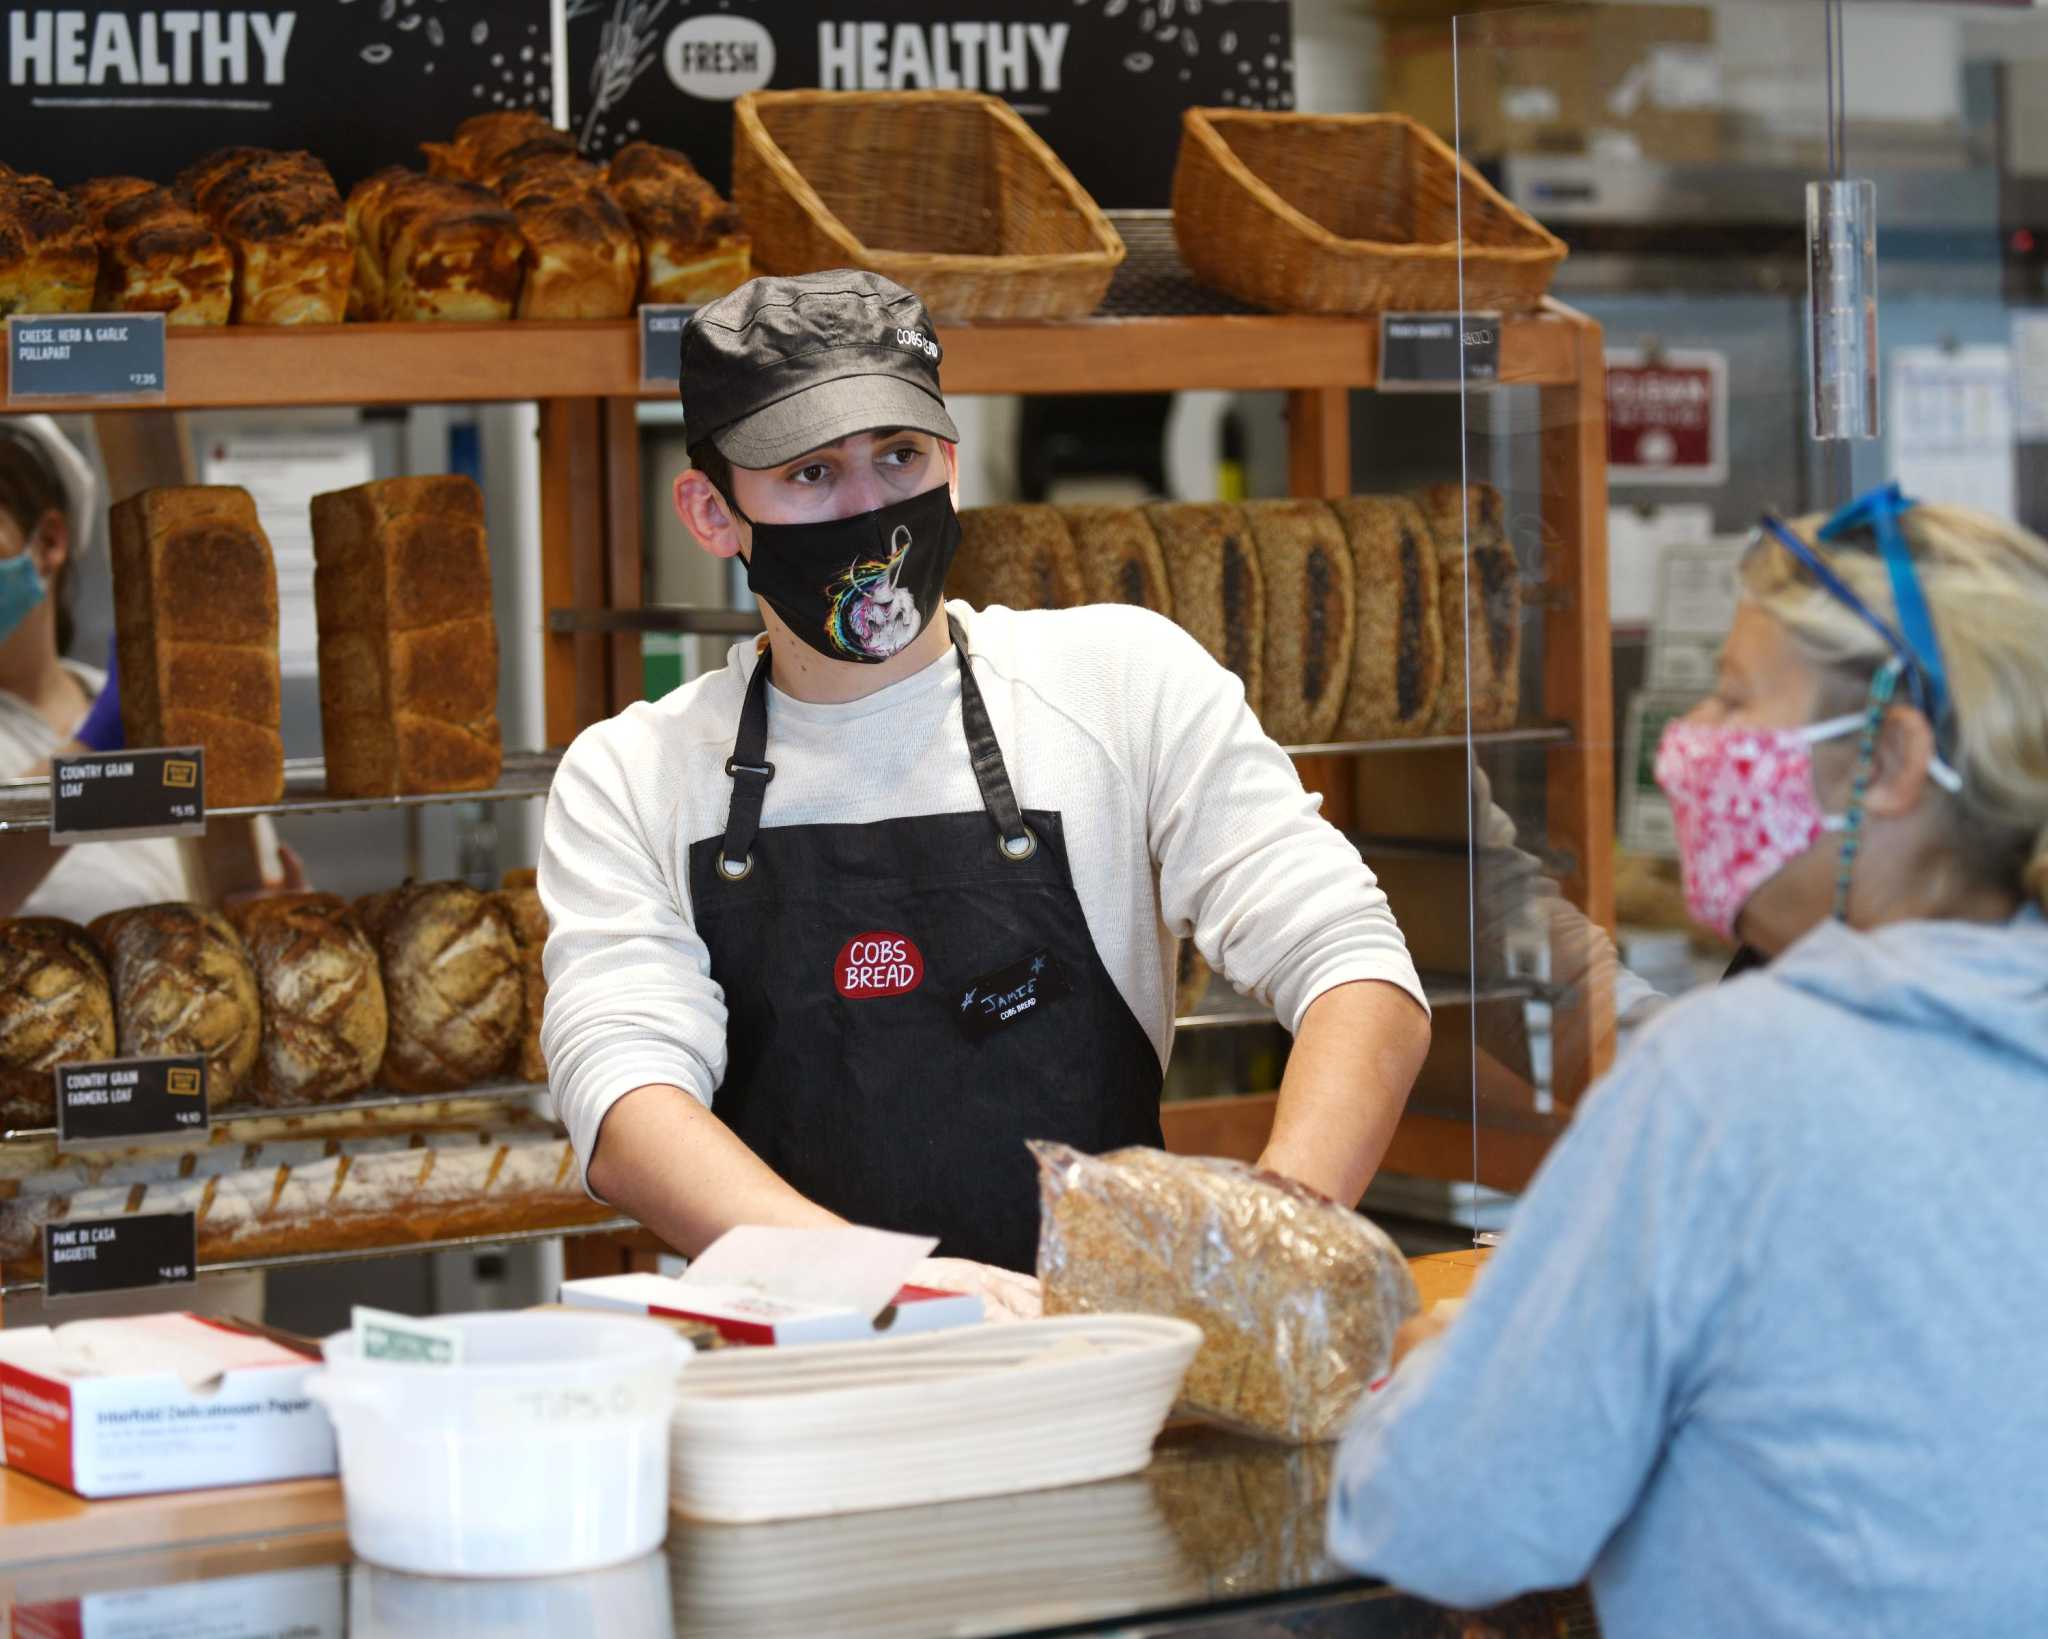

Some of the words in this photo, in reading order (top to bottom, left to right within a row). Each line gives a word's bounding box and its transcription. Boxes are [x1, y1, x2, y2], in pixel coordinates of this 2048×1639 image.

[9, 11, 297, 85] HEALTHY
[682, 41, 759, 74] FRESH
[818, 21, 1069, 91] HEALTHY
[58, 328, 82, 342] HERB
[84, 328, 93, 342] &
[96, 327, 128, 341] GARLIC
[896, 328, 922, 348] COBS
[19, 346, 70, 360] PULLAPART
[60, 764, 101, 780] COUNTRY
[105, 762, 134, 777] GRAIN
[60, 783, 83, 798] LOAF
[850, 940, 907, 965] COBS
[844, 964, 914, 989] BREAD
[980, 977, 1037, 1014] JAMIE
[1000, 1007, 1017, 1021] COBS
[1016, 997, 1036, 1013] BREAD
[67, 1072, 108, 1089] COUNTRY
[110, 1070, 139, 1085] GRAIN
[67, 1090, 109, 1106] FARMERS
[111, 1088, 132, 1103] LOAF
[53, 1231, 76, 1245] PANE
[79, 1230, 89, 1243] DI
[92, 1228, 116, 1242] CASA
[54, 1246, 97, 1263] BAGUETTE
